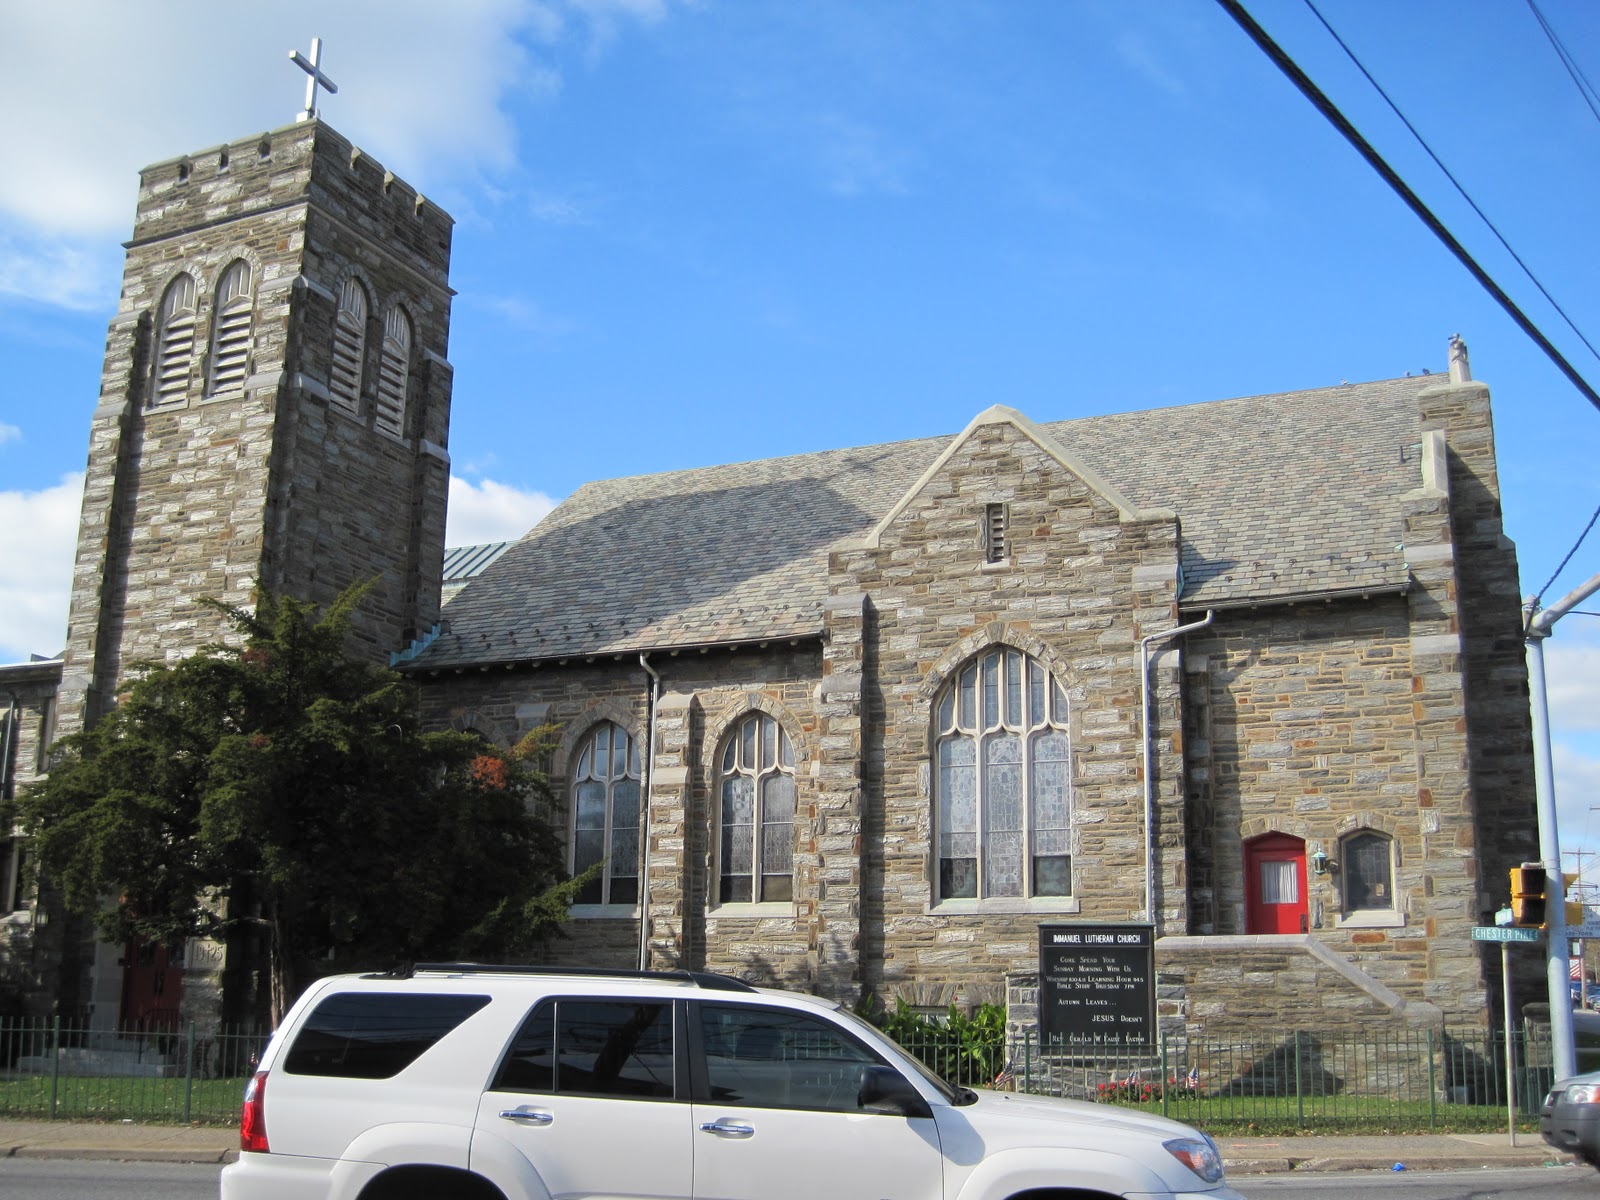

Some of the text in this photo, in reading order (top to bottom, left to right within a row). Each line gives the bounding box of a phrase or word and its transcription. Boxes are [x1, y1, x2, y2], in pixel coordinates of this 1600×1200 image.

[1053, 934, 1140, 943] IMMANUEL LUTHERAN CHURCH
[1476, 928, 1534, 940] CHESTER PIKE
